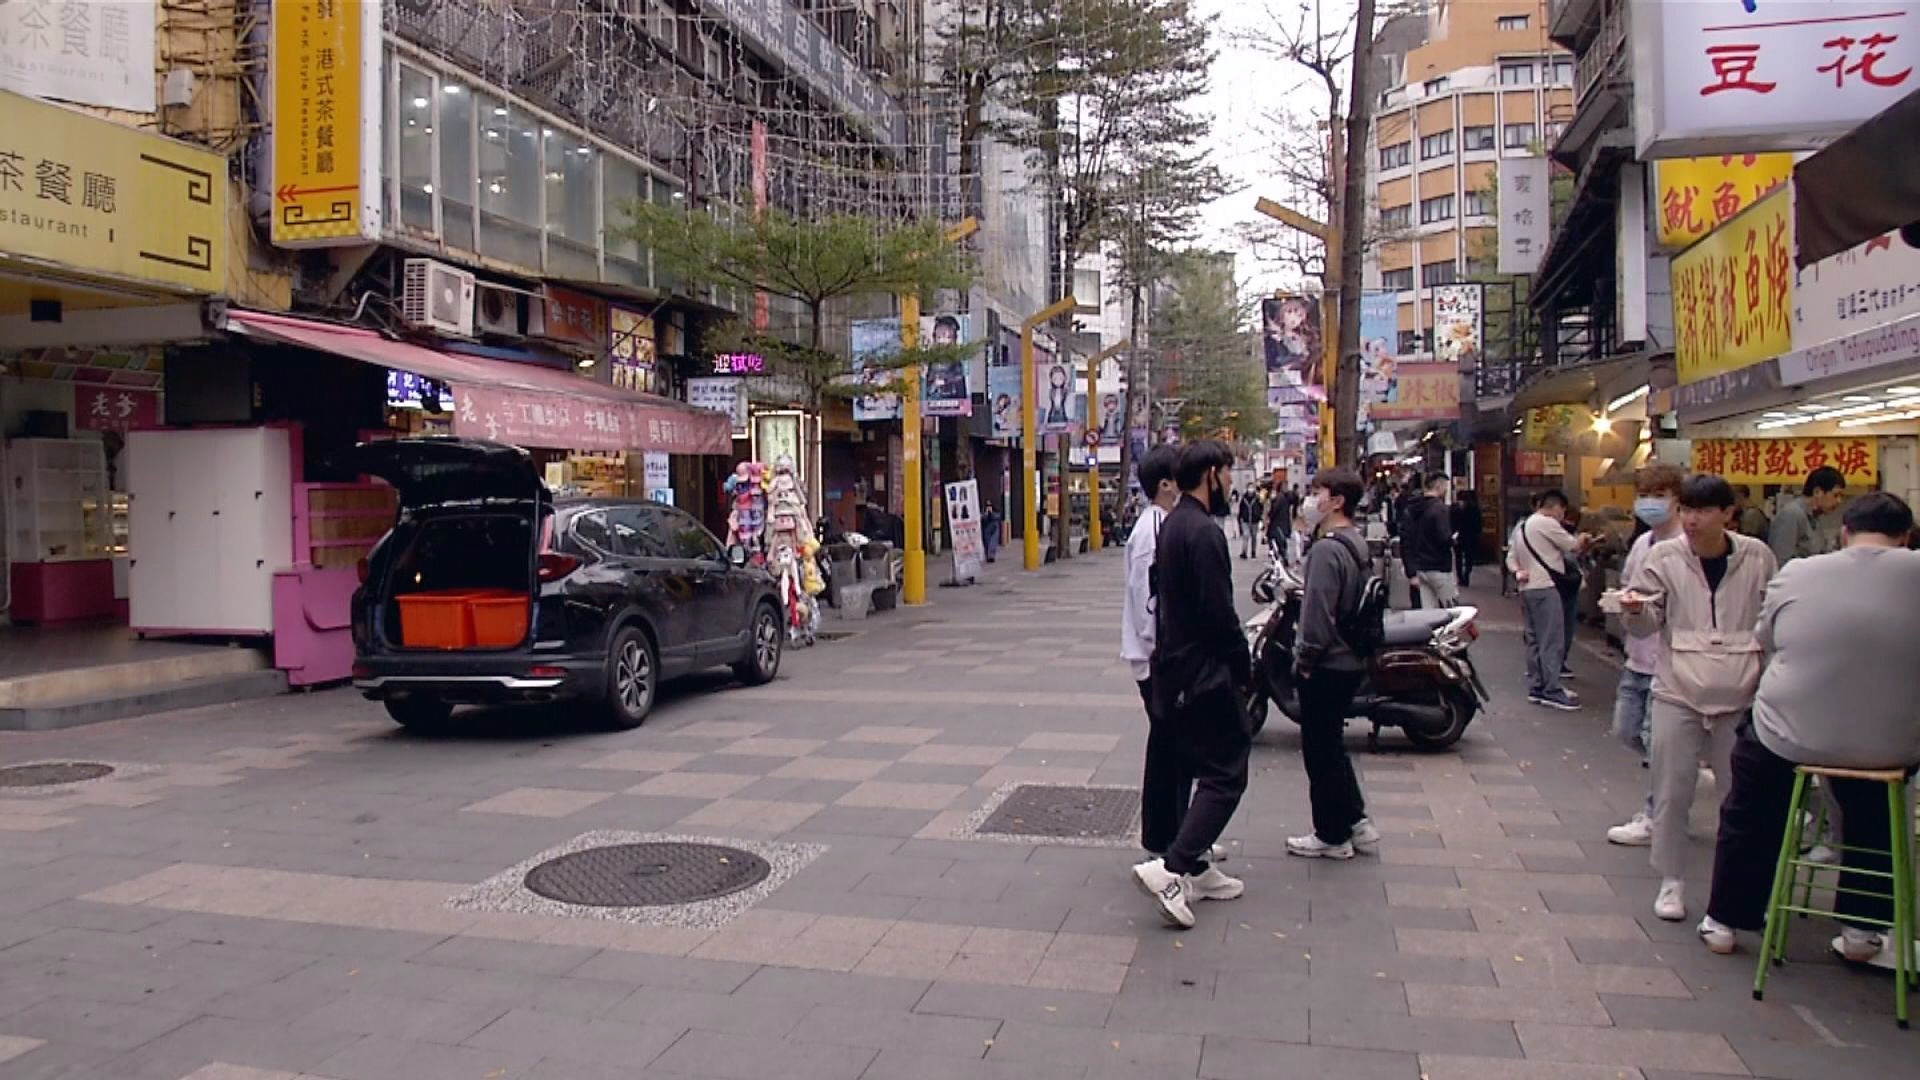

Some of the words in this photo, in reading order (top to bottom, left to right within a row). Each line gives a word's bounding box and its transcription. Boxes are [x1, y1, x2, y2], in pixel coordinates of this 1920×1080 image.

[1700, 32, 1913, 96] 豆花
[0, 151, 117, 213] 茶餐廳
